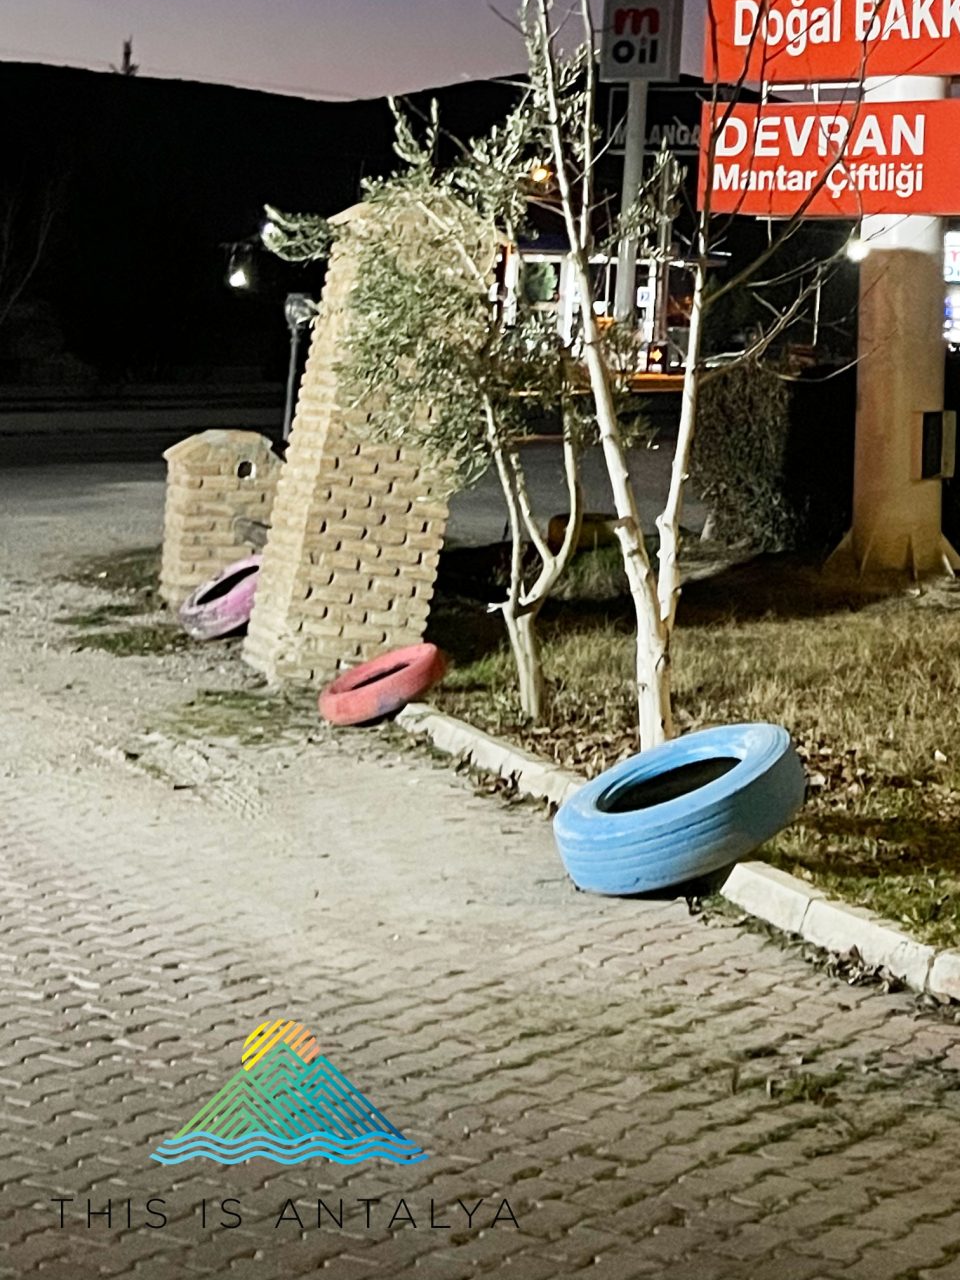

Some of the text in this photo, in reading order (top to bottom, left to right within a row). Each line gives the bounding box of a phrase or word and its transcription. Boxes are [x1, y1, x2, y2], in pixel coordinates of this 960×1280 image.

[612, 38, 659, 65] oil
[714, 114, 925, 158] DEVRAN
[711, 162, 924, 199] Mantar Çiftliği
